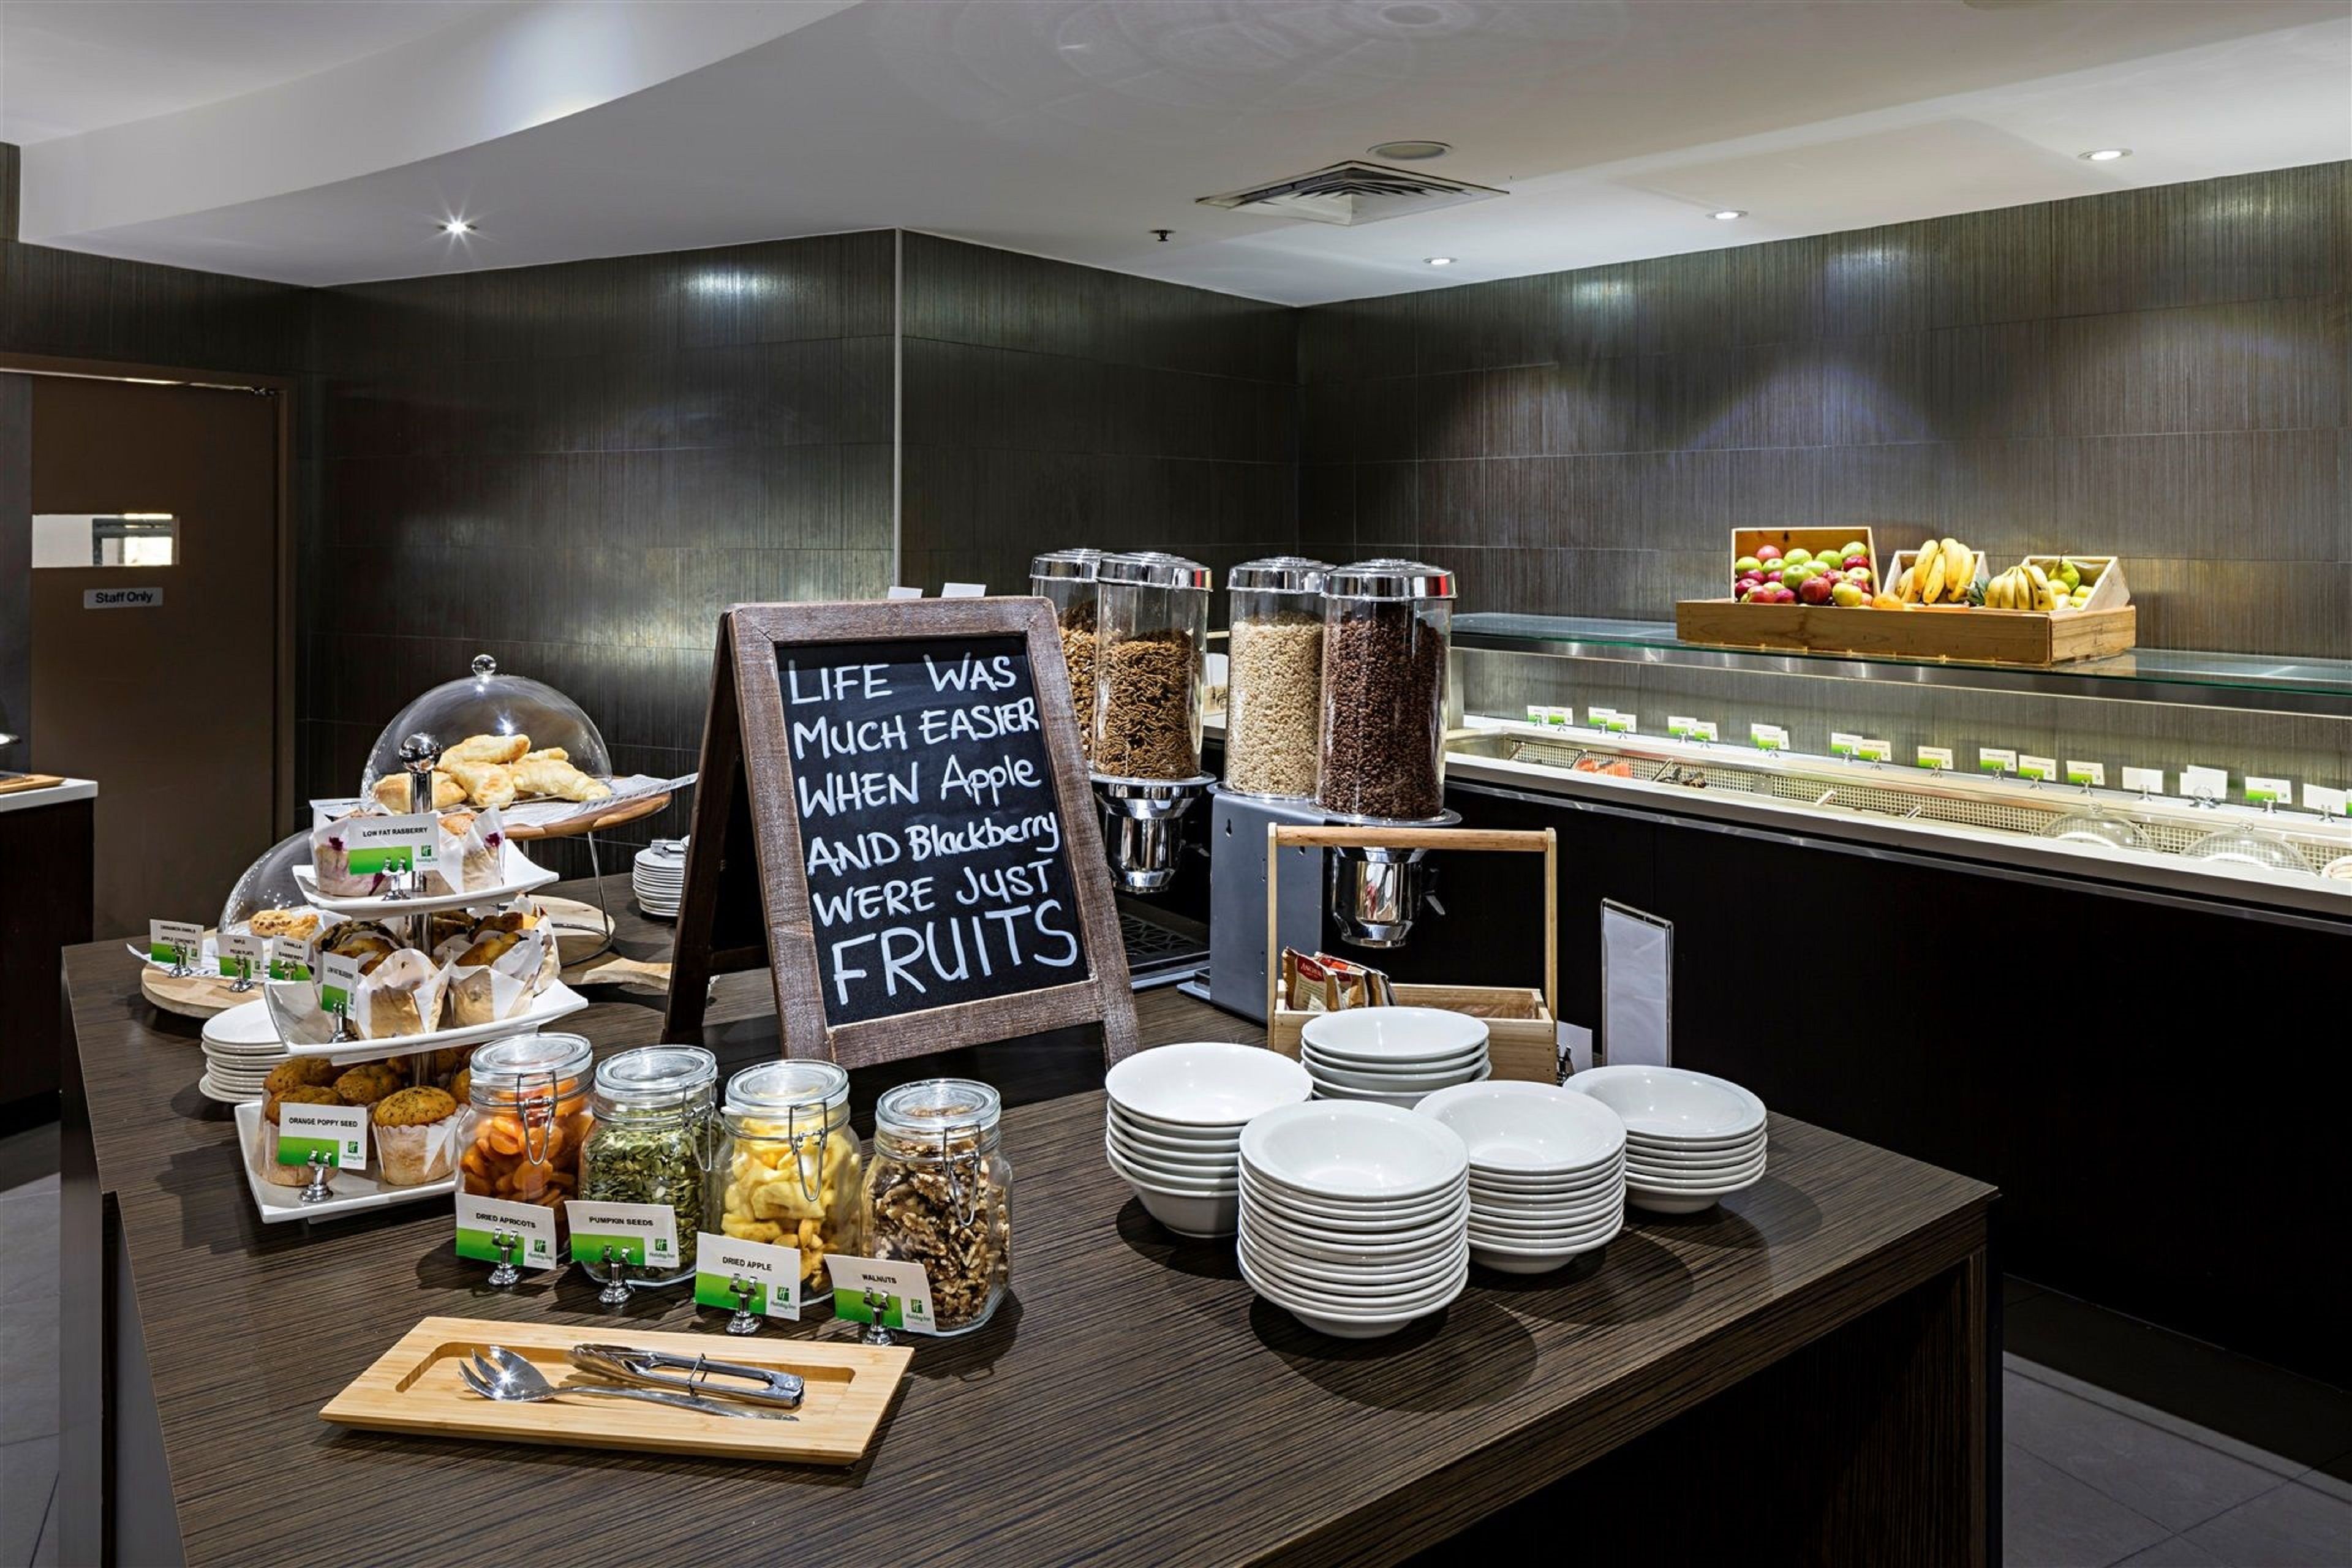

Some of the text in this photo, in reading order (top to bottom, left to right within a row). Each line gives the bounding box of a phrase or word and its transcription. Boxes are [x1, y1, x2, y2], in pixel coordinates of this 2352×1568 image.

[96, 590, 153, 604] Staff Only
[789, 652, 1017, 704] LIFE WAS
[793, 698, 1039, 760] MUCH EASIER
[798, 754, 1042, 818] WHEN Apple
[391, 826, 428, 835] RASBERRY
[807, 812, 1059, 877] AND Blackberry
[812, 859, 1053, 927] WERE JUST
[832, 900, 1079, 1005] FRUITS
[288, 1117, 316, 1126] ORANGE
[317, 1118, 338, 1127] POPPY
[476, 1212, 537, 1229] DRIED APRICOTS
[589, 1216, 624, 1225] PUMPKIN
[722, 1256, 772, 1271] DRIED APPLE
[862, 1273, 897, 1284] WALNUTS
